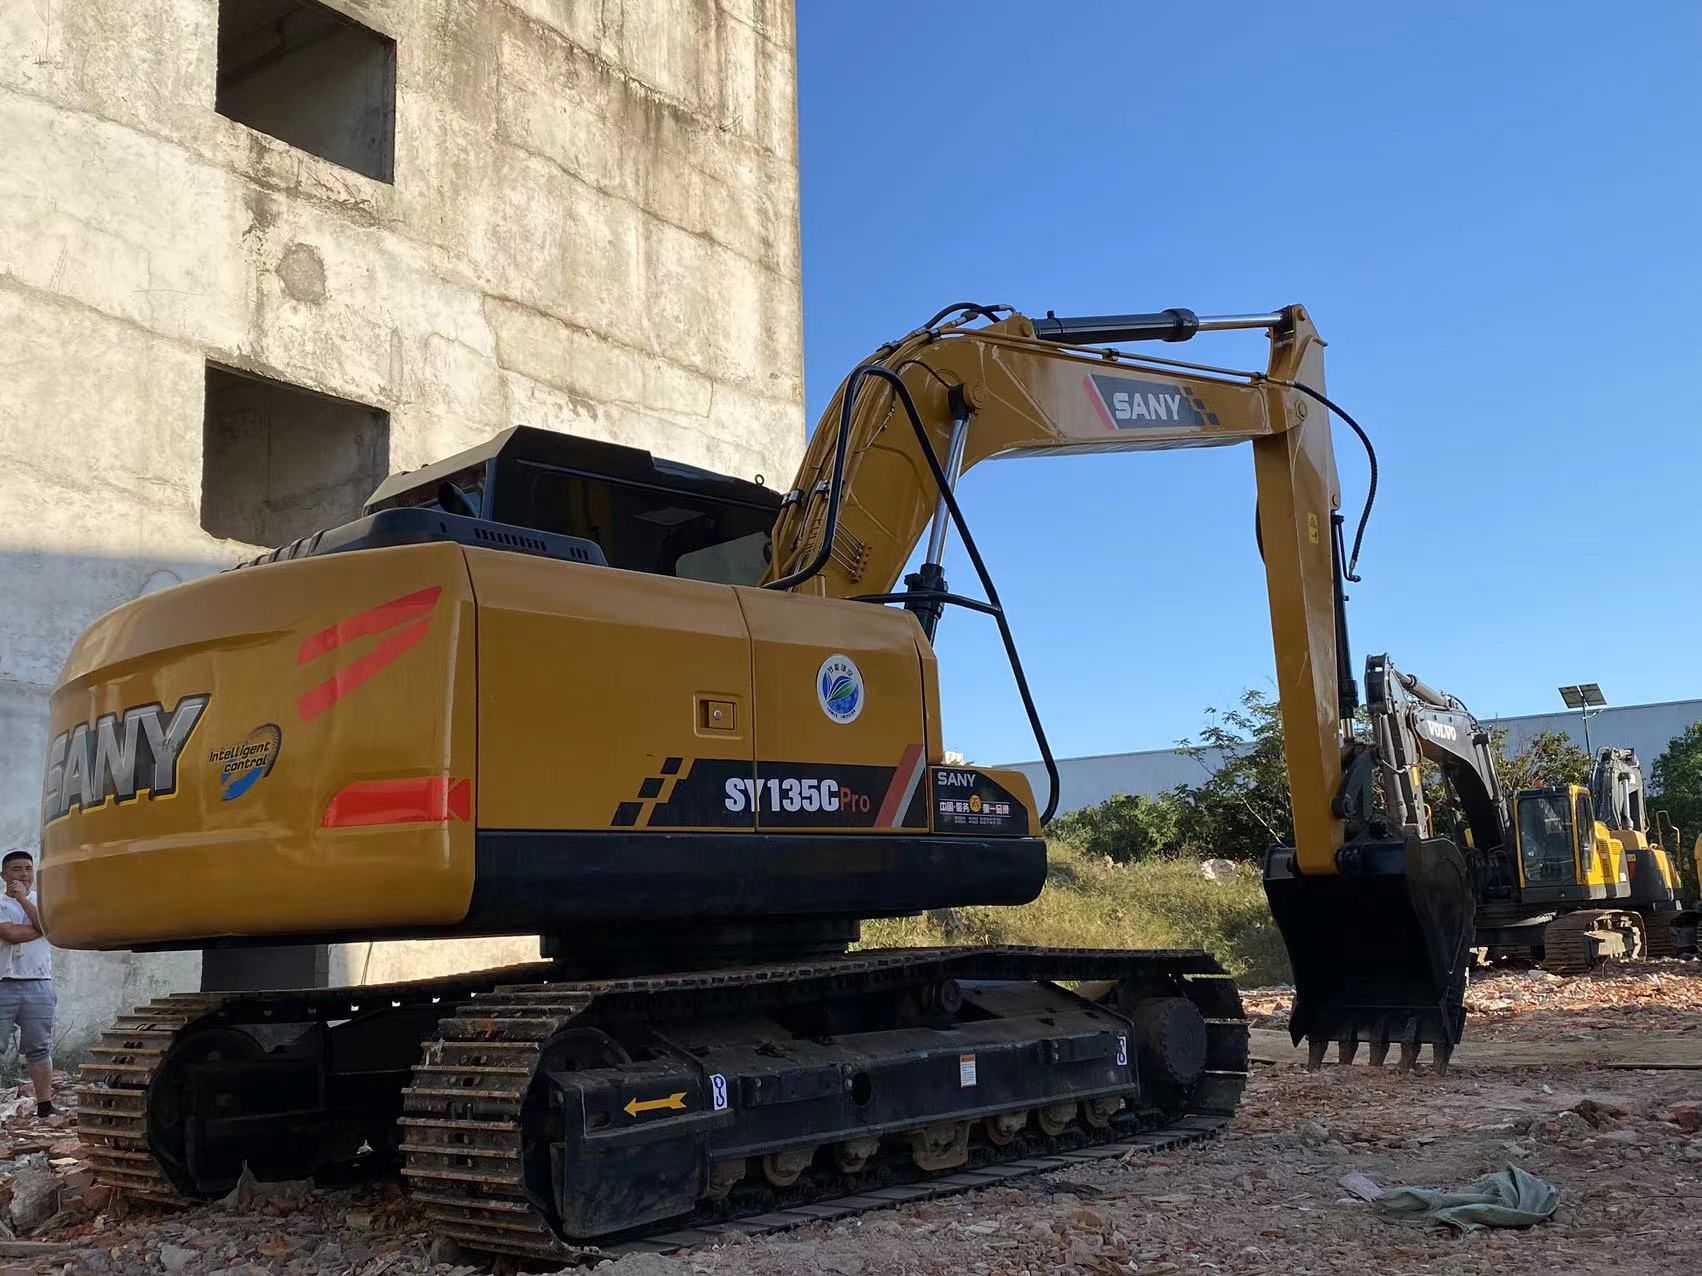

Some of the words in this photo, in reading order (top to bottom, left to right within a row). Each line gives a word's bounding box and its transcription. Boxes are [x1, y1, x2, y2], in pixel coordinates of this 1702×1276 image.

[1112, 392, 1181, 420] SANY
[1427, 719, 1457, 741] VOLVO
[45, 693, 212, 825] SANY
[209, 740, 271, 763] Intelligent
[224, 753, 268, 773] control
[937, 771, 976, 787] SANY
